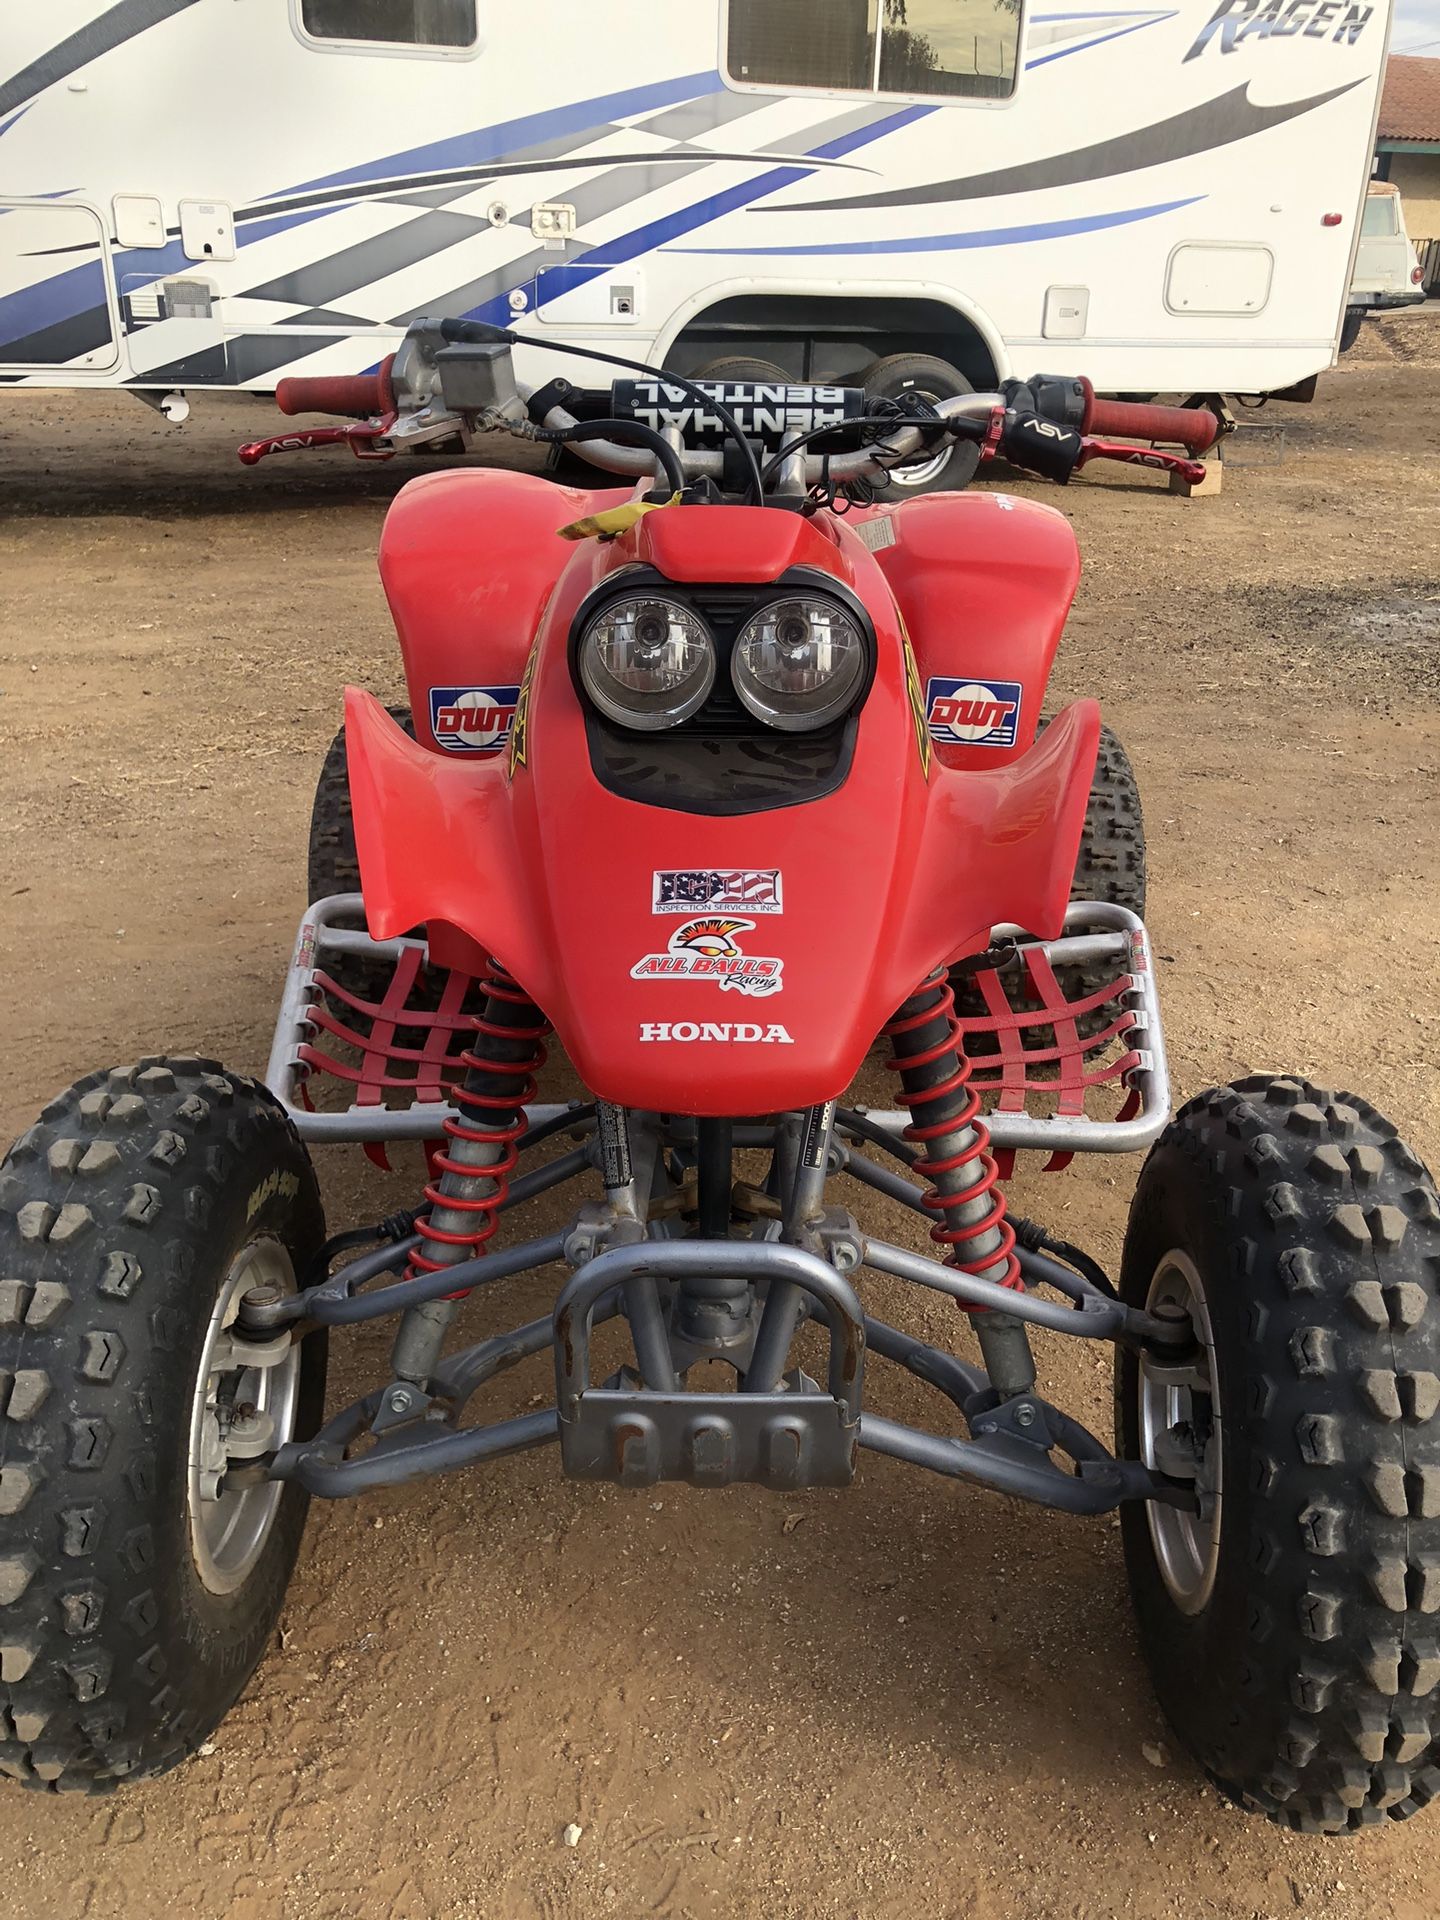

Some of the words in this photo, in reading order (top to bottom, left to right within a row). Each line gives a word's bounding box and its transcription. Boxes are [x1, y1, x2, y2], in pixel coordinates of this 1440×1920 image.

[634, 382, 845, 404] RENTHAL
[634, 408, 844, 433] RENTHAL
[1023, 419, 1072, 441] ASV
[269, 436, 312, 453] ASV
[1127, 452, 1177, 470] ASV
[437, 706, 517, 733] DWT
[927, 696, 1016, 729] DWT
[656, 904, 711, 912] INSPECTION
[636, 957, 687, 974] ALL
[689, 957, 778, 977] BALLS
[724, 973, 777, 992] Racing
[640, 1022, 795, 1044] HONDA
